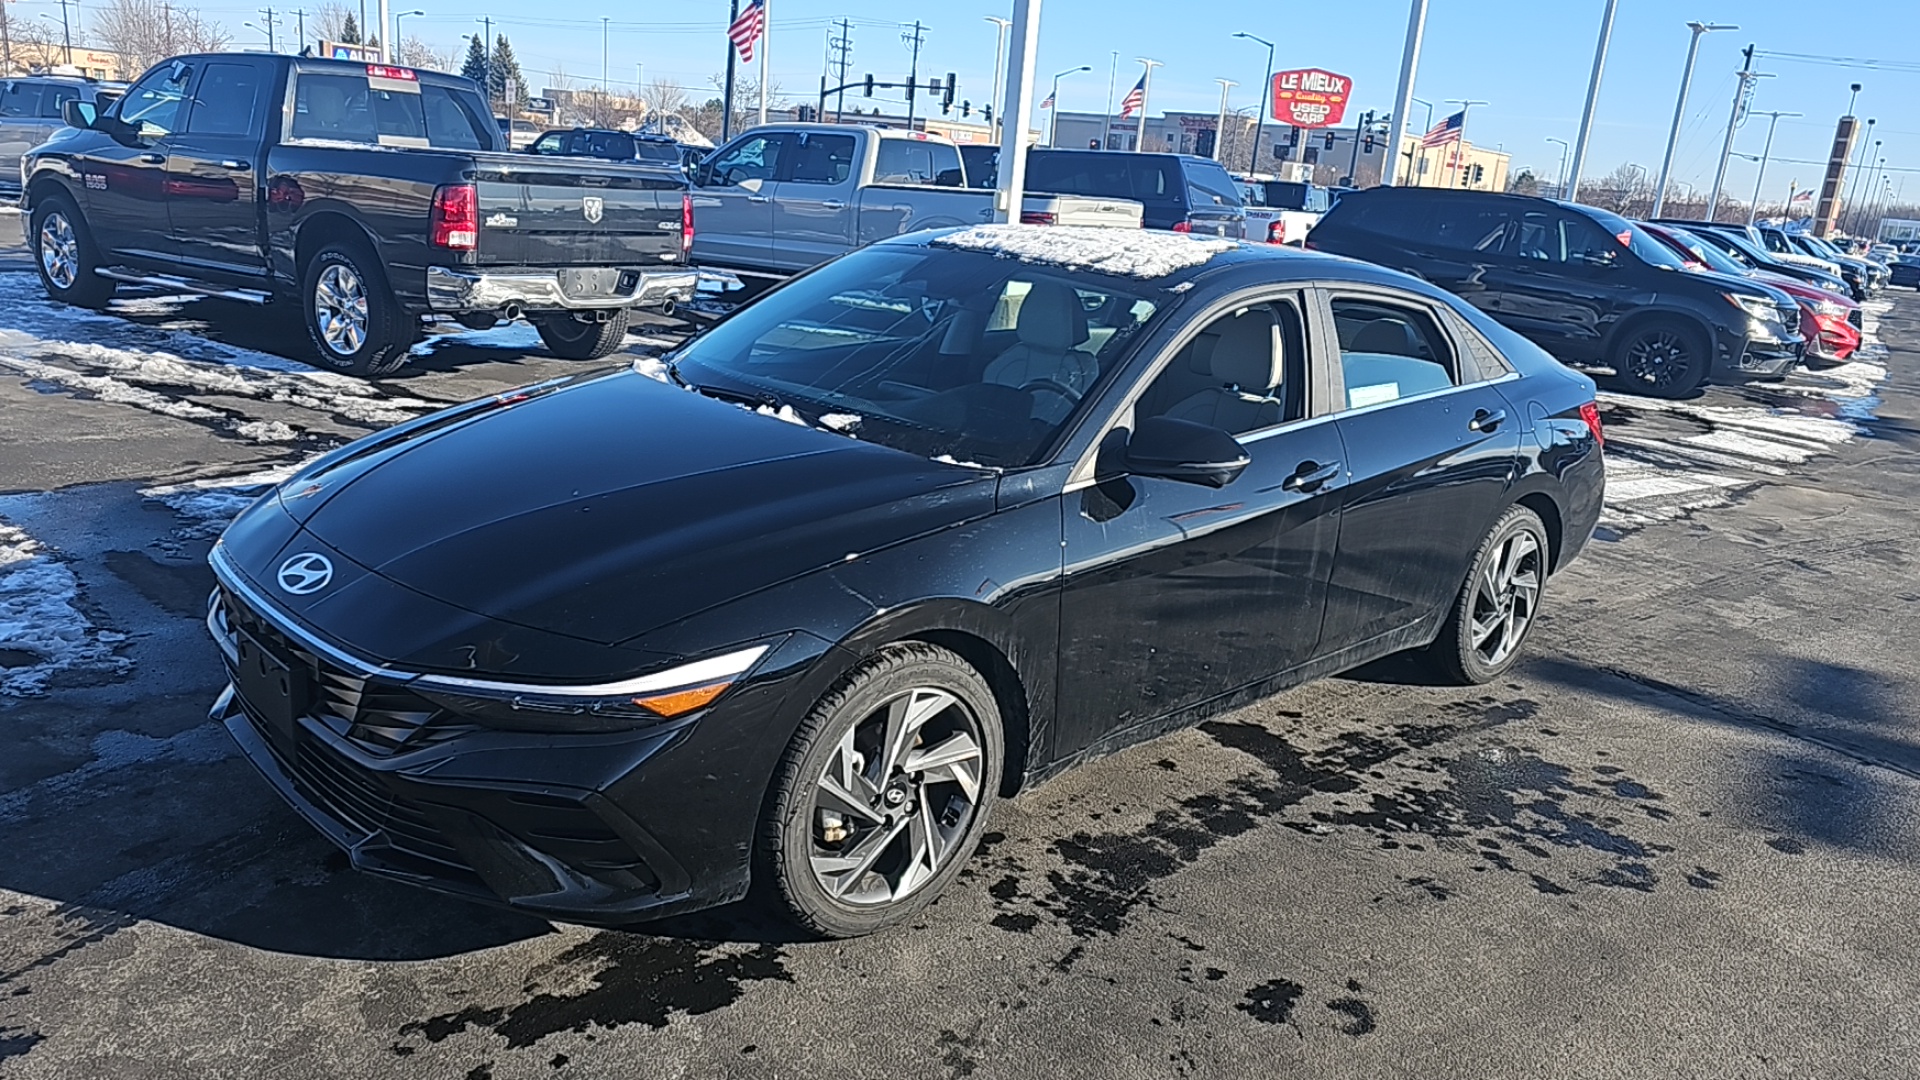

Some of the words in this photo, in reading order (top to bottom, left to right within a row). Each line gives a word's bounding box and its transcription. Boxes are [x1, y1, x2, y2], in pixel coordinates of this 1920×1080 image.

[349, 50, 379, 64] ALDI
[1280, 74, 1299, 90] LE
[1301, 71, 1345, 94] MIEUX
[1295, 91, 1327, 104] Quality
[1290, 102, 1331, 115] USED
[1293, 112, 1325, 124] CARS
